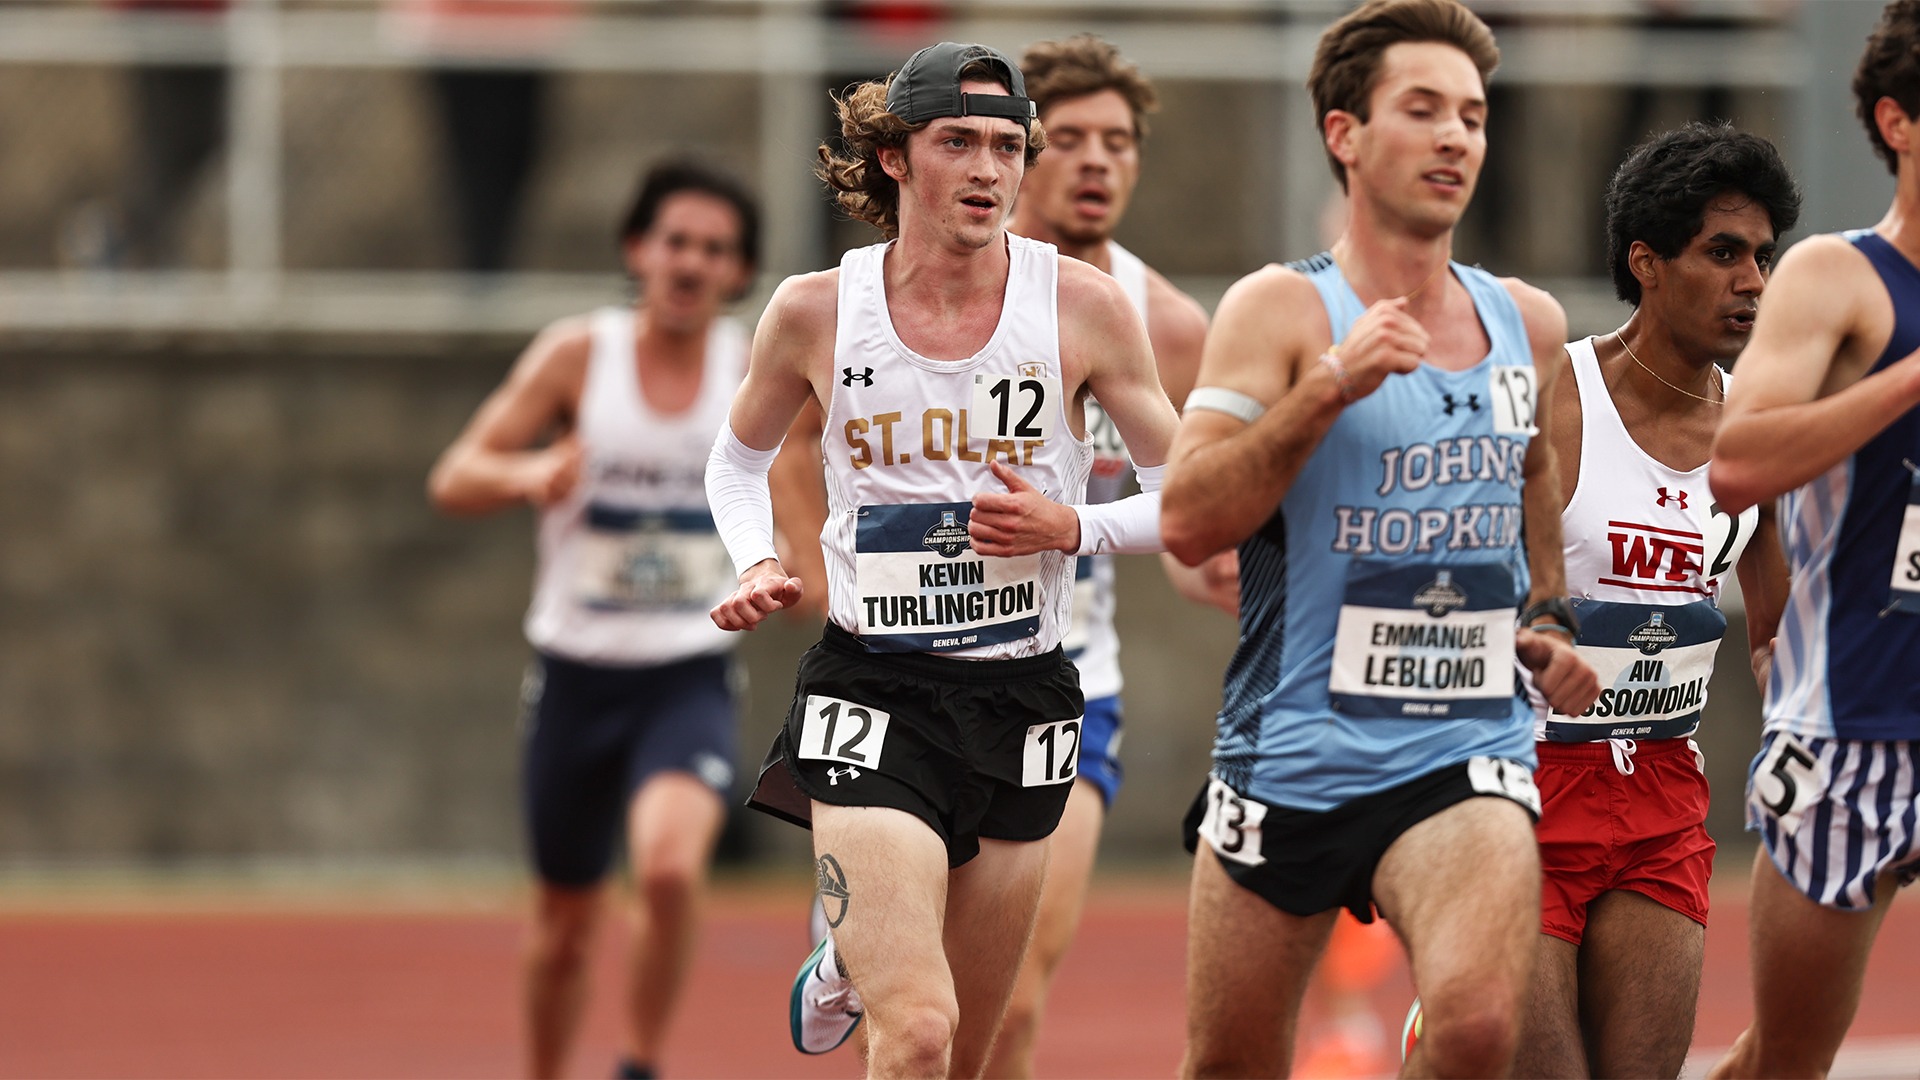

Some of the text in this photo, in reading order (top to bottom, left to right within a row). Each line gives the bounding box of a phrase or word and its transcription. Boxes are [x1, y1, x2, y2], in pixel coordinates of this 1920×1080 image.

[989, 378, 1045, 438] 12
[1499, 370, 1535, 429] 13
[844, 411, 911, 471] ST.
[1376, 434, 1527, 497] JOHNS
[924, 535, 972, 545] CHAMPIONSHIP
[1331, 502, 1522, 555] HOPKIN
[918, 560, 985, 588] KEVIN
[862, 581, 1035, 628] TURLINGTON
[932, 634, 978, 648] GENEVA, OHIO
[1371, 622, 1487, 649] EMMANUEL
[1364, 654, 1486, 690] LEBLOND
[1628, 660, 1664, 682] AVI
[1552, 677, 1704, 718] SOONDIAL
[818, 701, 873, 763] 12
[1037, 720, 1080, 781] 12
[1610, 726, 1652, 736] GENEVA, OHIO
[1762, 743, 1816, 818] 5
[1216, 789, 1246, 854] 13
